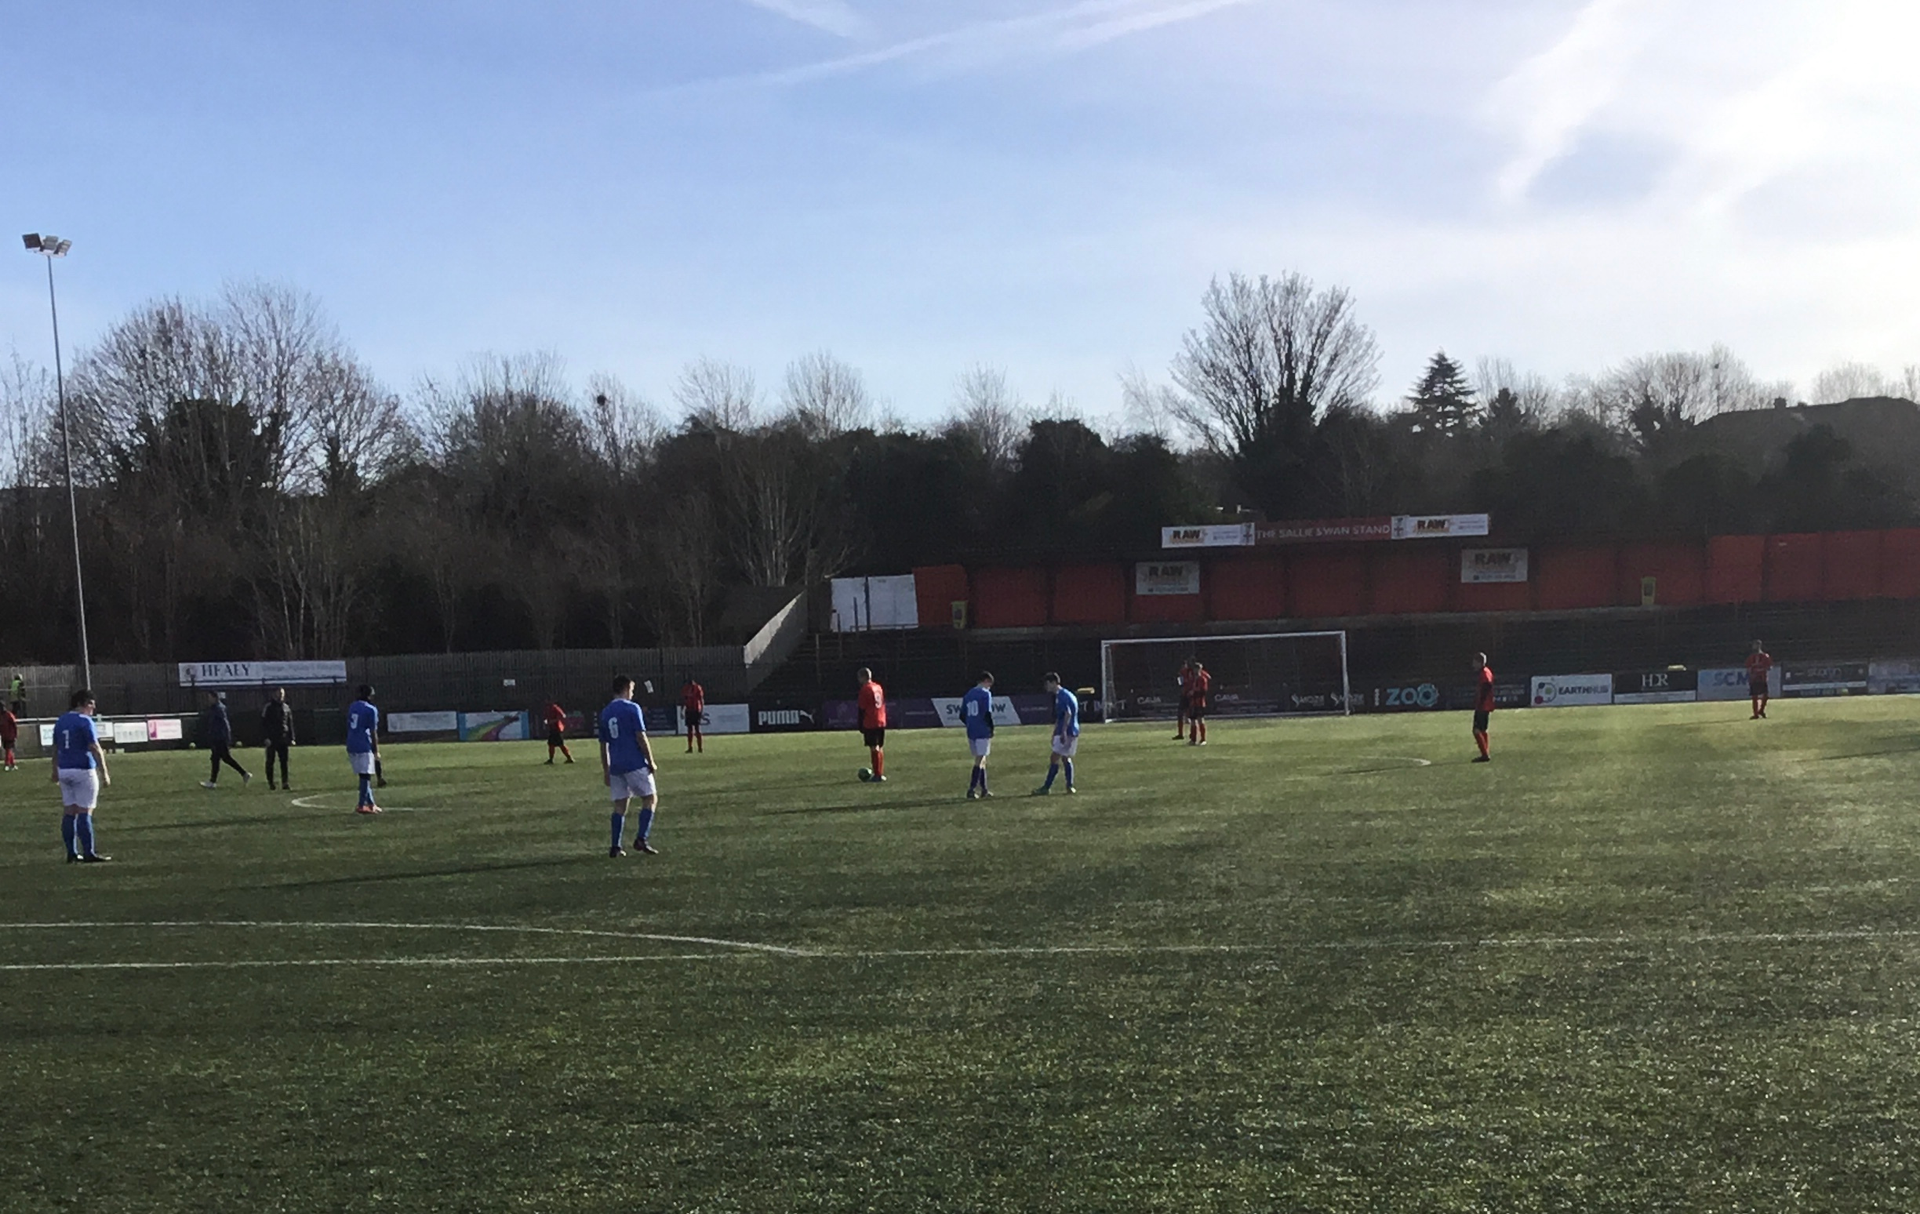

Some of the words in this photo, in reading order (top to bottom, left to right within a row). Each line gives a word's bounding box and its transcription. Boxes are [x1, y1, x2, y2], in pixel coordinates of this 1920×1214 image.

[1257, 530, 1276, 539] THE
[1316, 526, 1350, 536] SWAN
[1353, 524, 1391, 535] STAND
[1416, 519, 1447, 530] RAW
[1172, 529, 1202, 540] RAW
[966, 700, 980, 717] 10
[758, 710, 801, 726] PUMA
[608, 716, 619, 739] 6
[62, 729, 71, 750] 1
